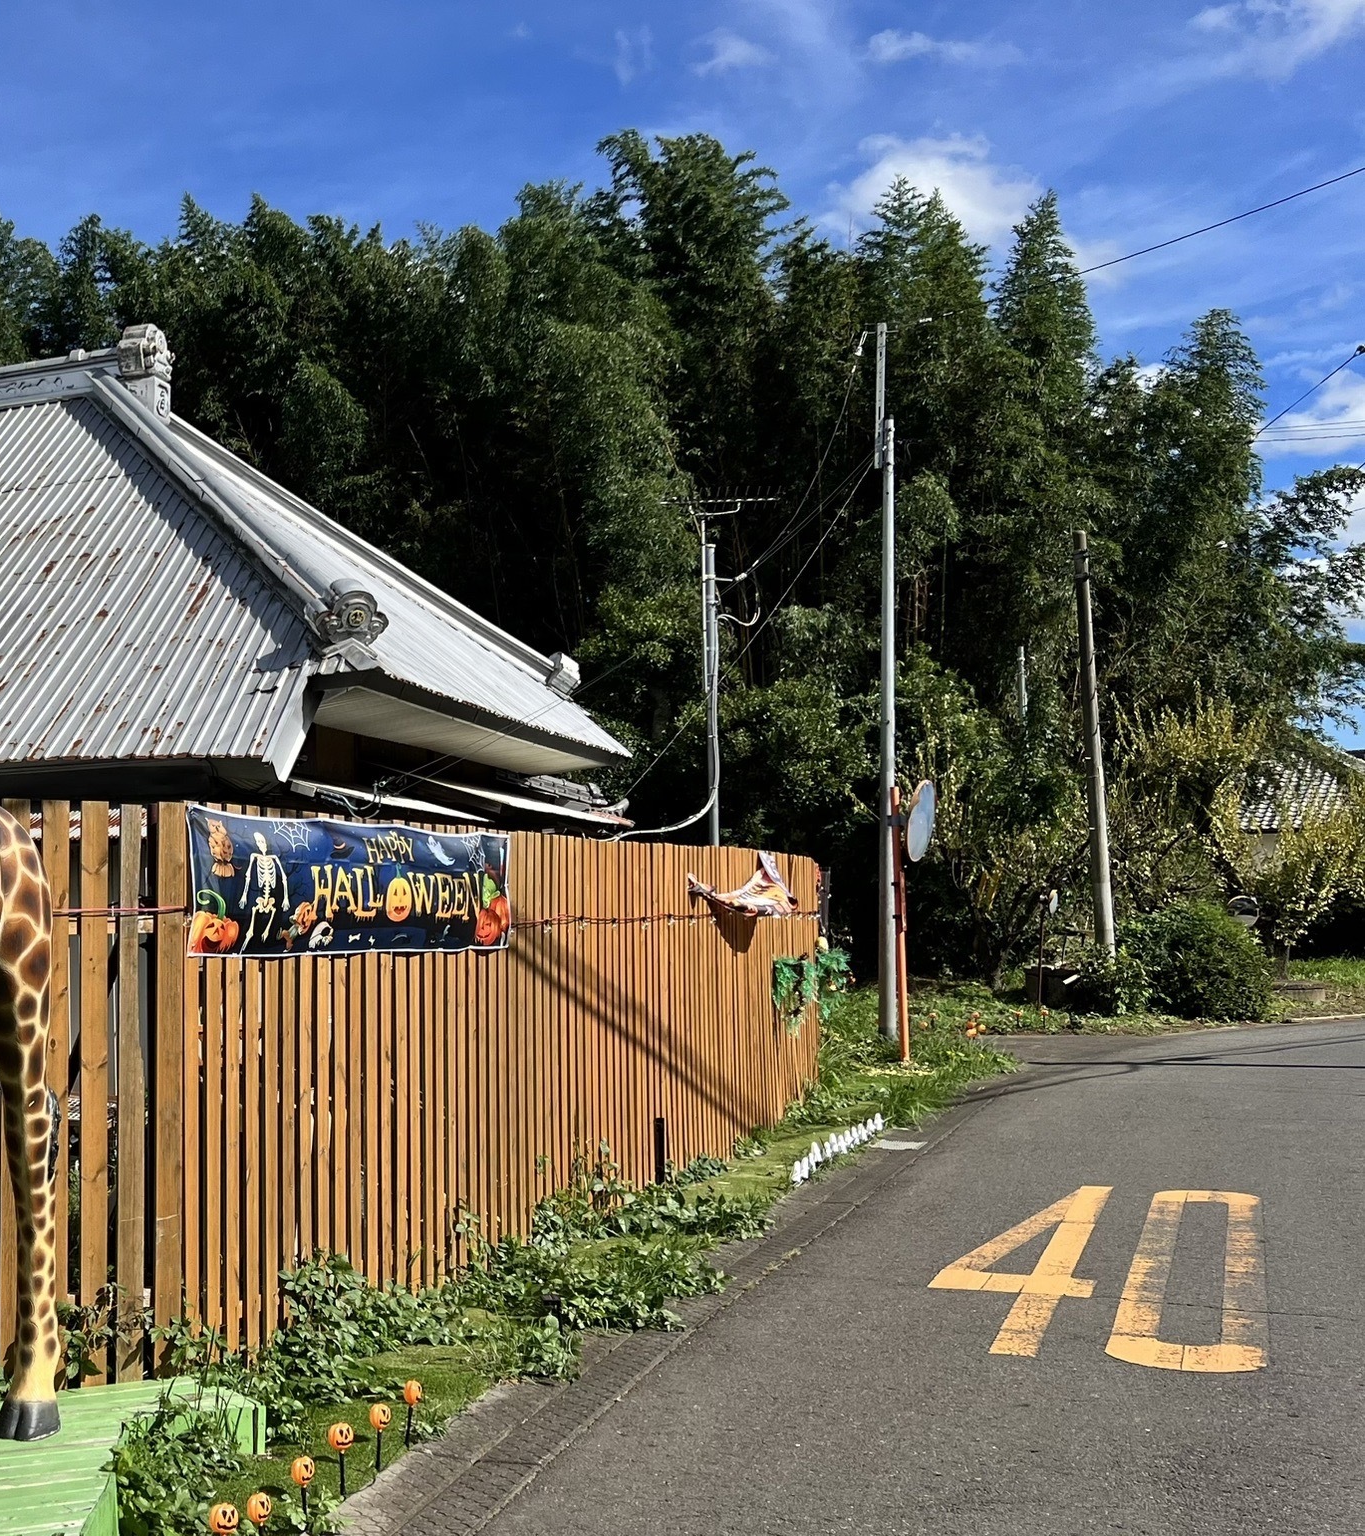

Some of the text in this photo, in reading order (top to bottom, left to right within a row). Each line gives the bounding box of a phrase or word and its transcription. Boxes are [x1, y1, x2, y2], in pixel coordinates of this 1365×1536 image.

[362, 831, 415, 863] HAPPY
[311, 865, 482, 923] HALLOWEEN
[927, 1185, 1268, 1373] 40
